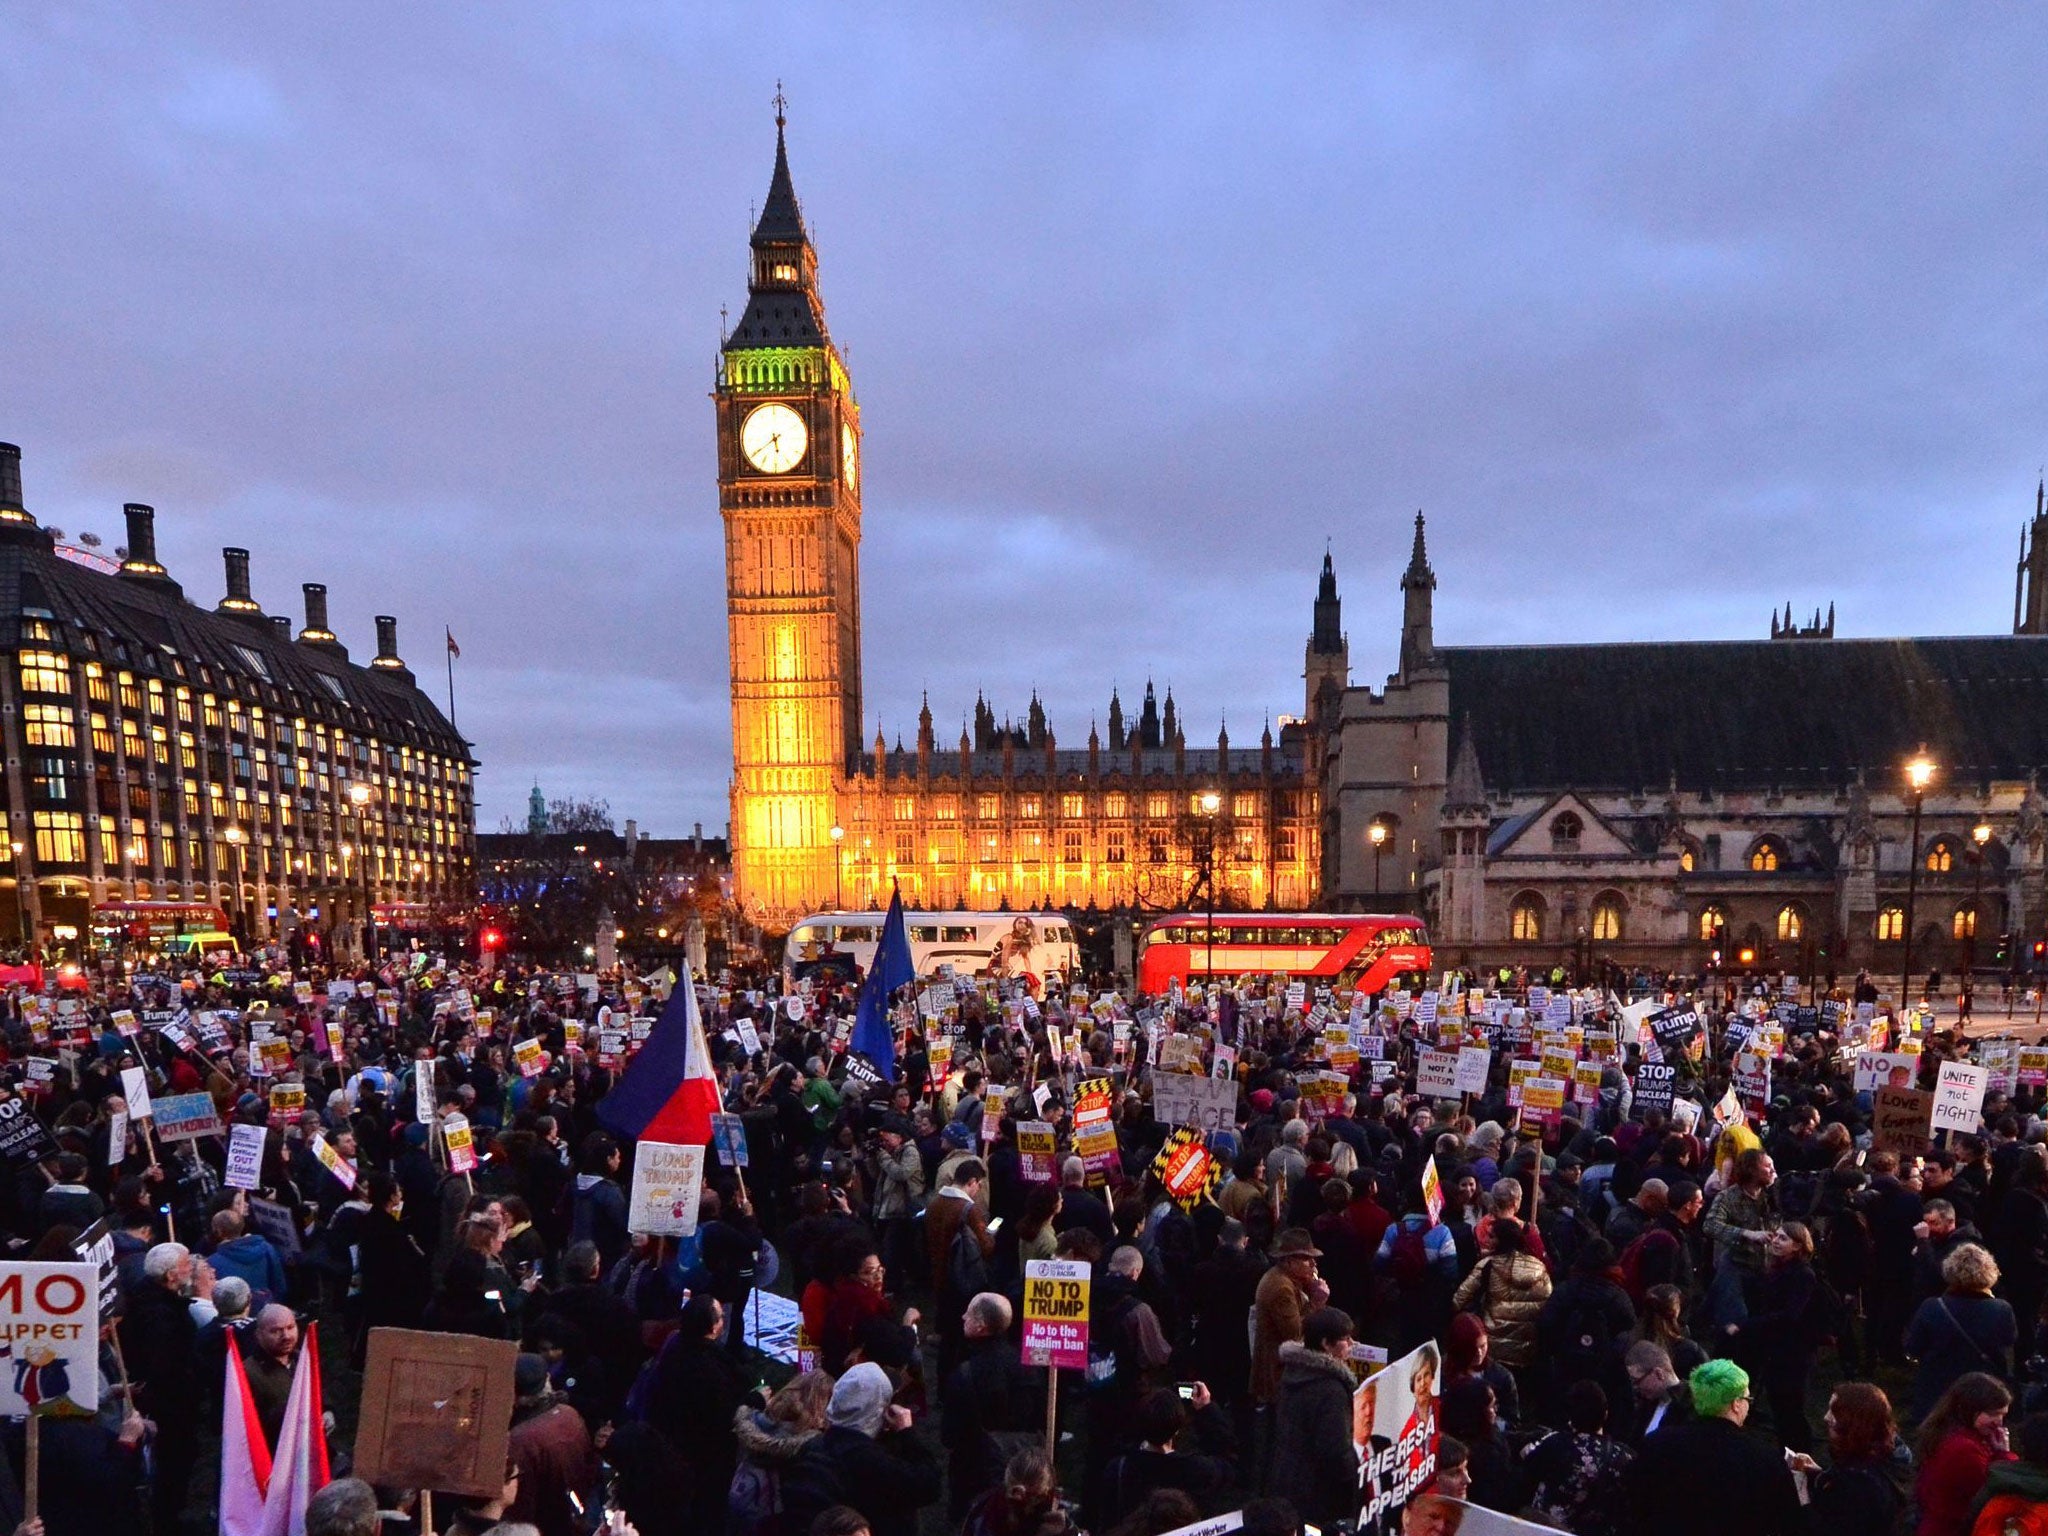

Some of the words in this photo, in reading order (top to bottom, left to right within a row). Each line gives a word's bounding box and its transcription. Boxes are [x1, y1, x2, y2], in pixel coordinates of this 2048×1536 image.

[142, 1010, 174, 1023] Trump
[1651, 1011, 1697, 1034] Trump
[942, 1025, 966, 1036] STOP
[1480, 1025, 1501, 1037] TOP
[1728, 1022, 1752, 1038] ump
[1764, 1019, 1780, 1029] STOP
[1359, 1035, 1381, 1046] LOVE
[1359, 1049, 1380, 1058] HATE
[1422, 1053, 1448, 1063] NASTY
[1372, 1065, 1393, 1076] DUMP
[1428, 1065, 1446, 1074] NOT
[1448, 1066, 1455, 1075] A
[1860, 1057, 1890, 1072] NO
[1638, 1064, 1676, 1080] STOP
[1943, 1070, 1977, 1086] UNITE
[1636, 1090, 1672, 1100] NUCLEAR
[1881, 1092, 1920, 1111] LOVE
[1947, 1090, 1969, 1101] not
[0, 1098, 23, 1119] OP
[1082, 1097, 1104, 1110] STOP
[1157, 1100, 1236, 1130] PEACE
[1935, 1104, 1978, 1122] FIGHT
[0, 1124, 42, 1150] NUCLEAR
[1020, 1134, 1032, 1143] NO
[1033, 1134, 1045, 1143] TO
[1020, 1141, 1051, 1152] RACISM
[234, 1155, 255, 1165] OUT
[1021, 1153, 1034, 1163] NO
[1168, 1145, 1192, 1176] STOP
[1022, 1162, 1033, 1173] TO
[643, 1168, 694, 1186] TRUMP
[1023, 1171, 1053, 1182] TRUMP
[1181, 1160, 1207, 1191] TRUMP
[1033, 1280, 1054, 1298] NO
[1059, 1281, 1081, 1299] TO
[1029, 1298, 1085, 1317] TRUMP
[1032, 1323, 1046, 1336] No
[1047, 1324, 1057, 1336] to
[1060, 1324, 1078, 1338] the
[1025, 1335, 1062, 1349] Muslim
[1063, 1337, 1084, 1351] ban
[801, 1351, 815, 1362] NO
[802, 1361, 813, 1372] TO
[1355, 1360, 1371, 1375] TO
[1357, 1414, 1435, 1489] THERESA
[1391, 1457, 1410, 1484] THE
[1357, 1453, 1436, 1532] APPEASER
[1202, 1523, 1228, 1536] Worker
